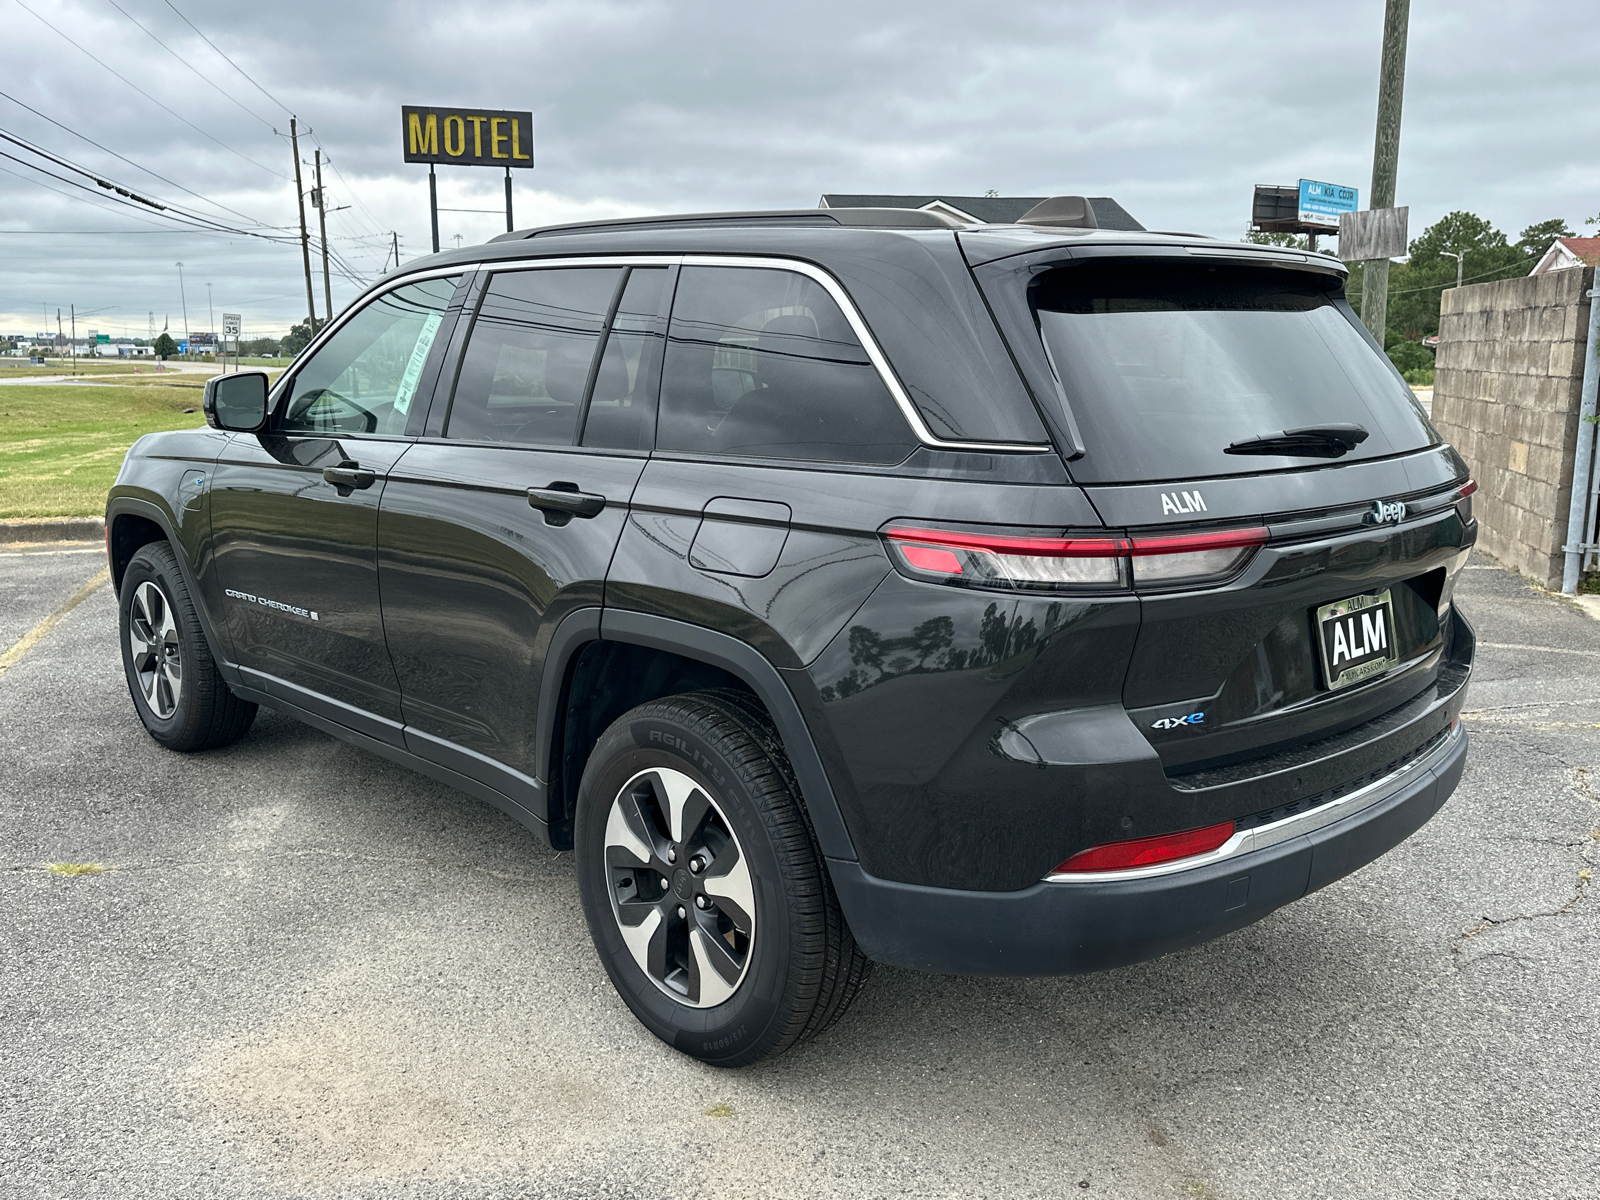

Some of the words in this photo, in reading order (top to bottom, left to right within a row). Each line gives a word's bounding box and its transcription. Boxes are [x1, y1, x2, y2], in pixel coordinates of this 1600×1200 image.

[408, 112, 530, 160] MOTEL
[1308, 184, 1321, 195] ALM
[1324, 187, 1334, 198] KIA
[225, 326, 239, 335] 35
[1160, 490, 1208, 516] ALM
[1373, 500, 1406, 524] Jeep
[225, 588, 257, 603] GRAND
[258, 597, 310, 618] CHEROKEE
[1347, 595, 1366, 612] ALM
[1332, 608, 1387, 667] ALM
[649, 730, 726, 786] AGILITY
